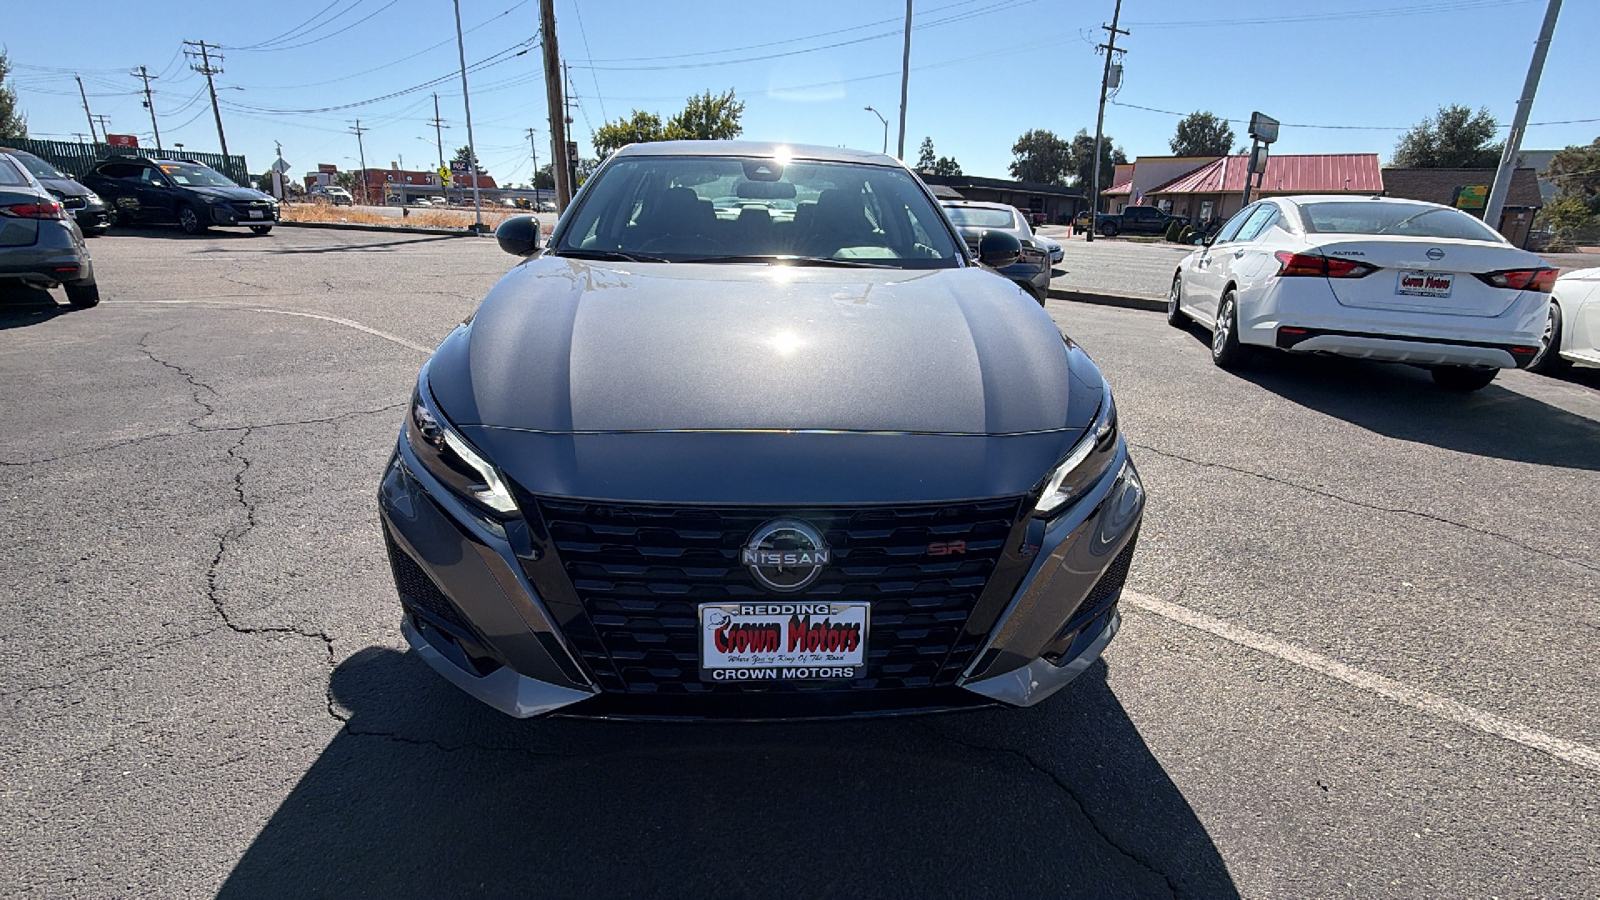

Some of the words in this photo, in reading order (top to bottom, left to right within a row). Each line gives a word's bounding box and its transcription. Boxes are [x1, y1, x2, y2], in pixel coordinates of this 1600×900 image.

[928, 540, 966, 556] SR
[744, 551, 828, 564] NISSAN
[741, 605, 829, 615] REDDING
[714, 617, 781, 653] Crown
[788, 615, 860, 653] Motors
[728, 655, 749, 663] Where
[798, 654, 807, 663] Of
[713, 669, 777, 680] CROWN
[782, 667, 854, 679] MOTORS
